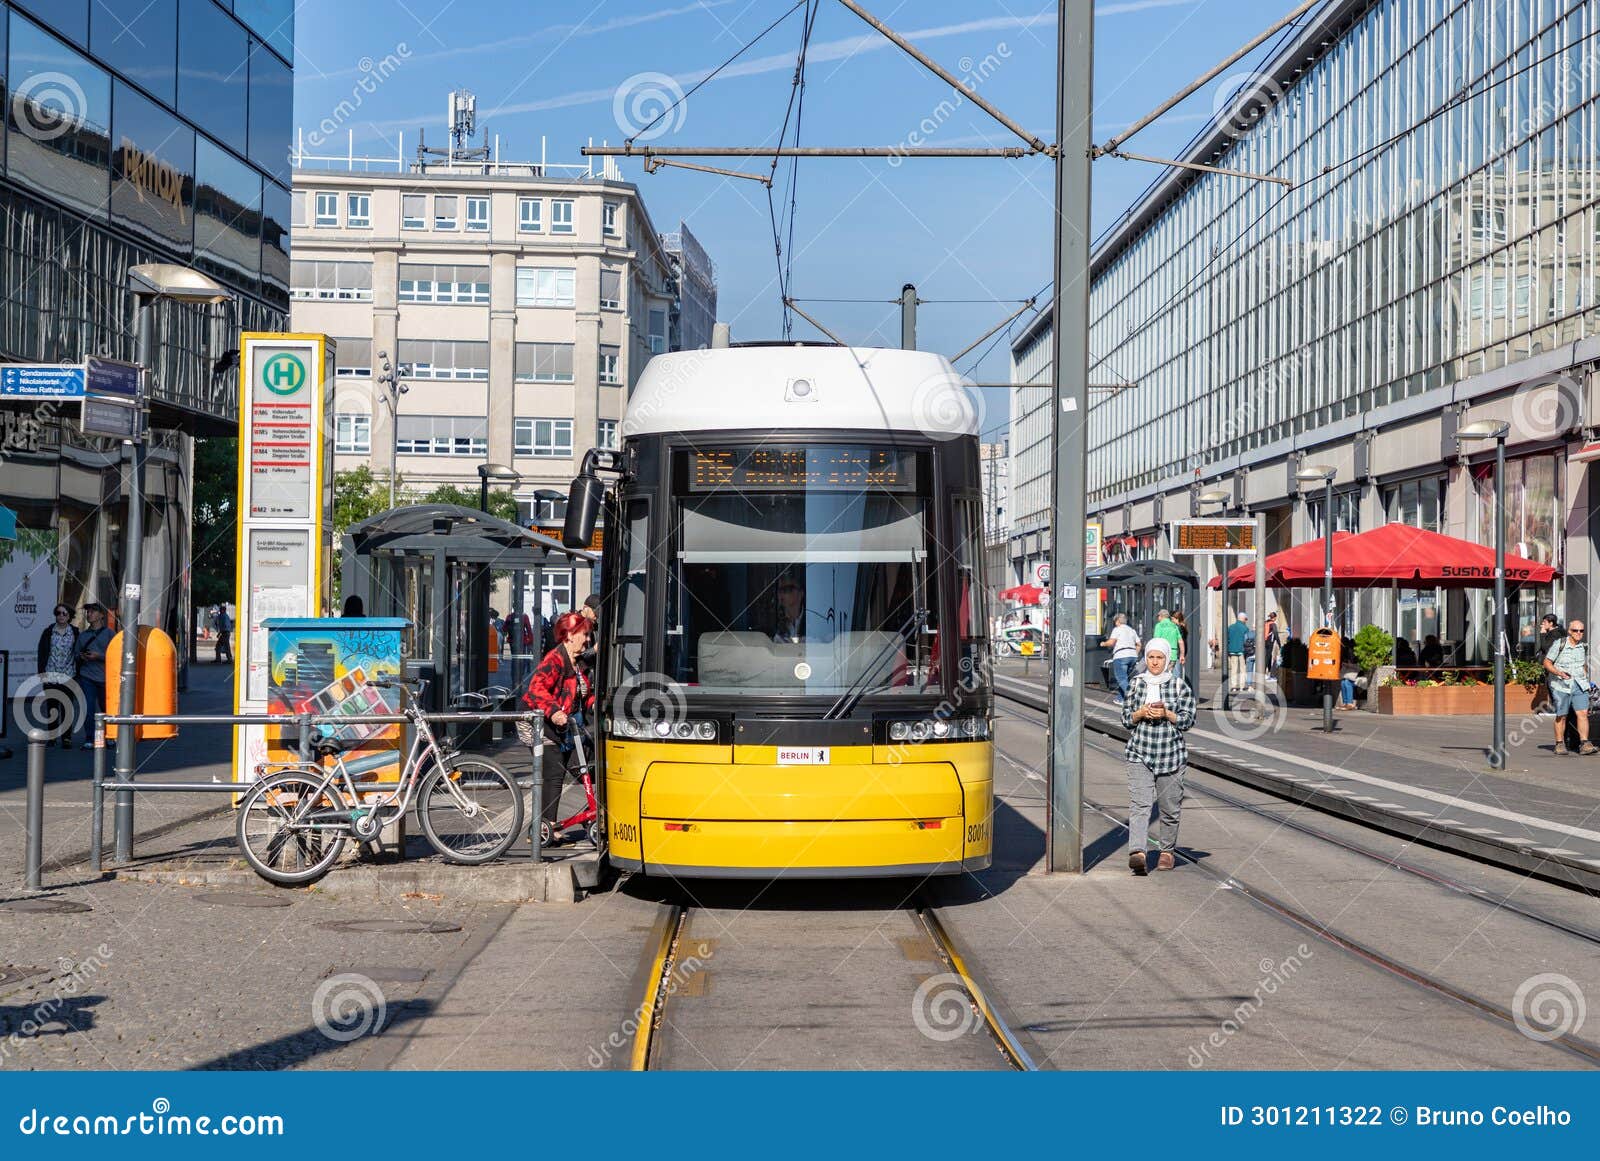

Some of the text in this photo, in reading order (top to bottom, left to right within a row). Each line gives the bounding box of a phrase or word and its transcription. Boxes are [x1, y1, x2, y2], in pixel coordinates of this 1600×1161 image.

[273, 362, 295, 386] H
[780, 751, 809, 760] BERLIN
[613, 822, 637, 843] A-8001
